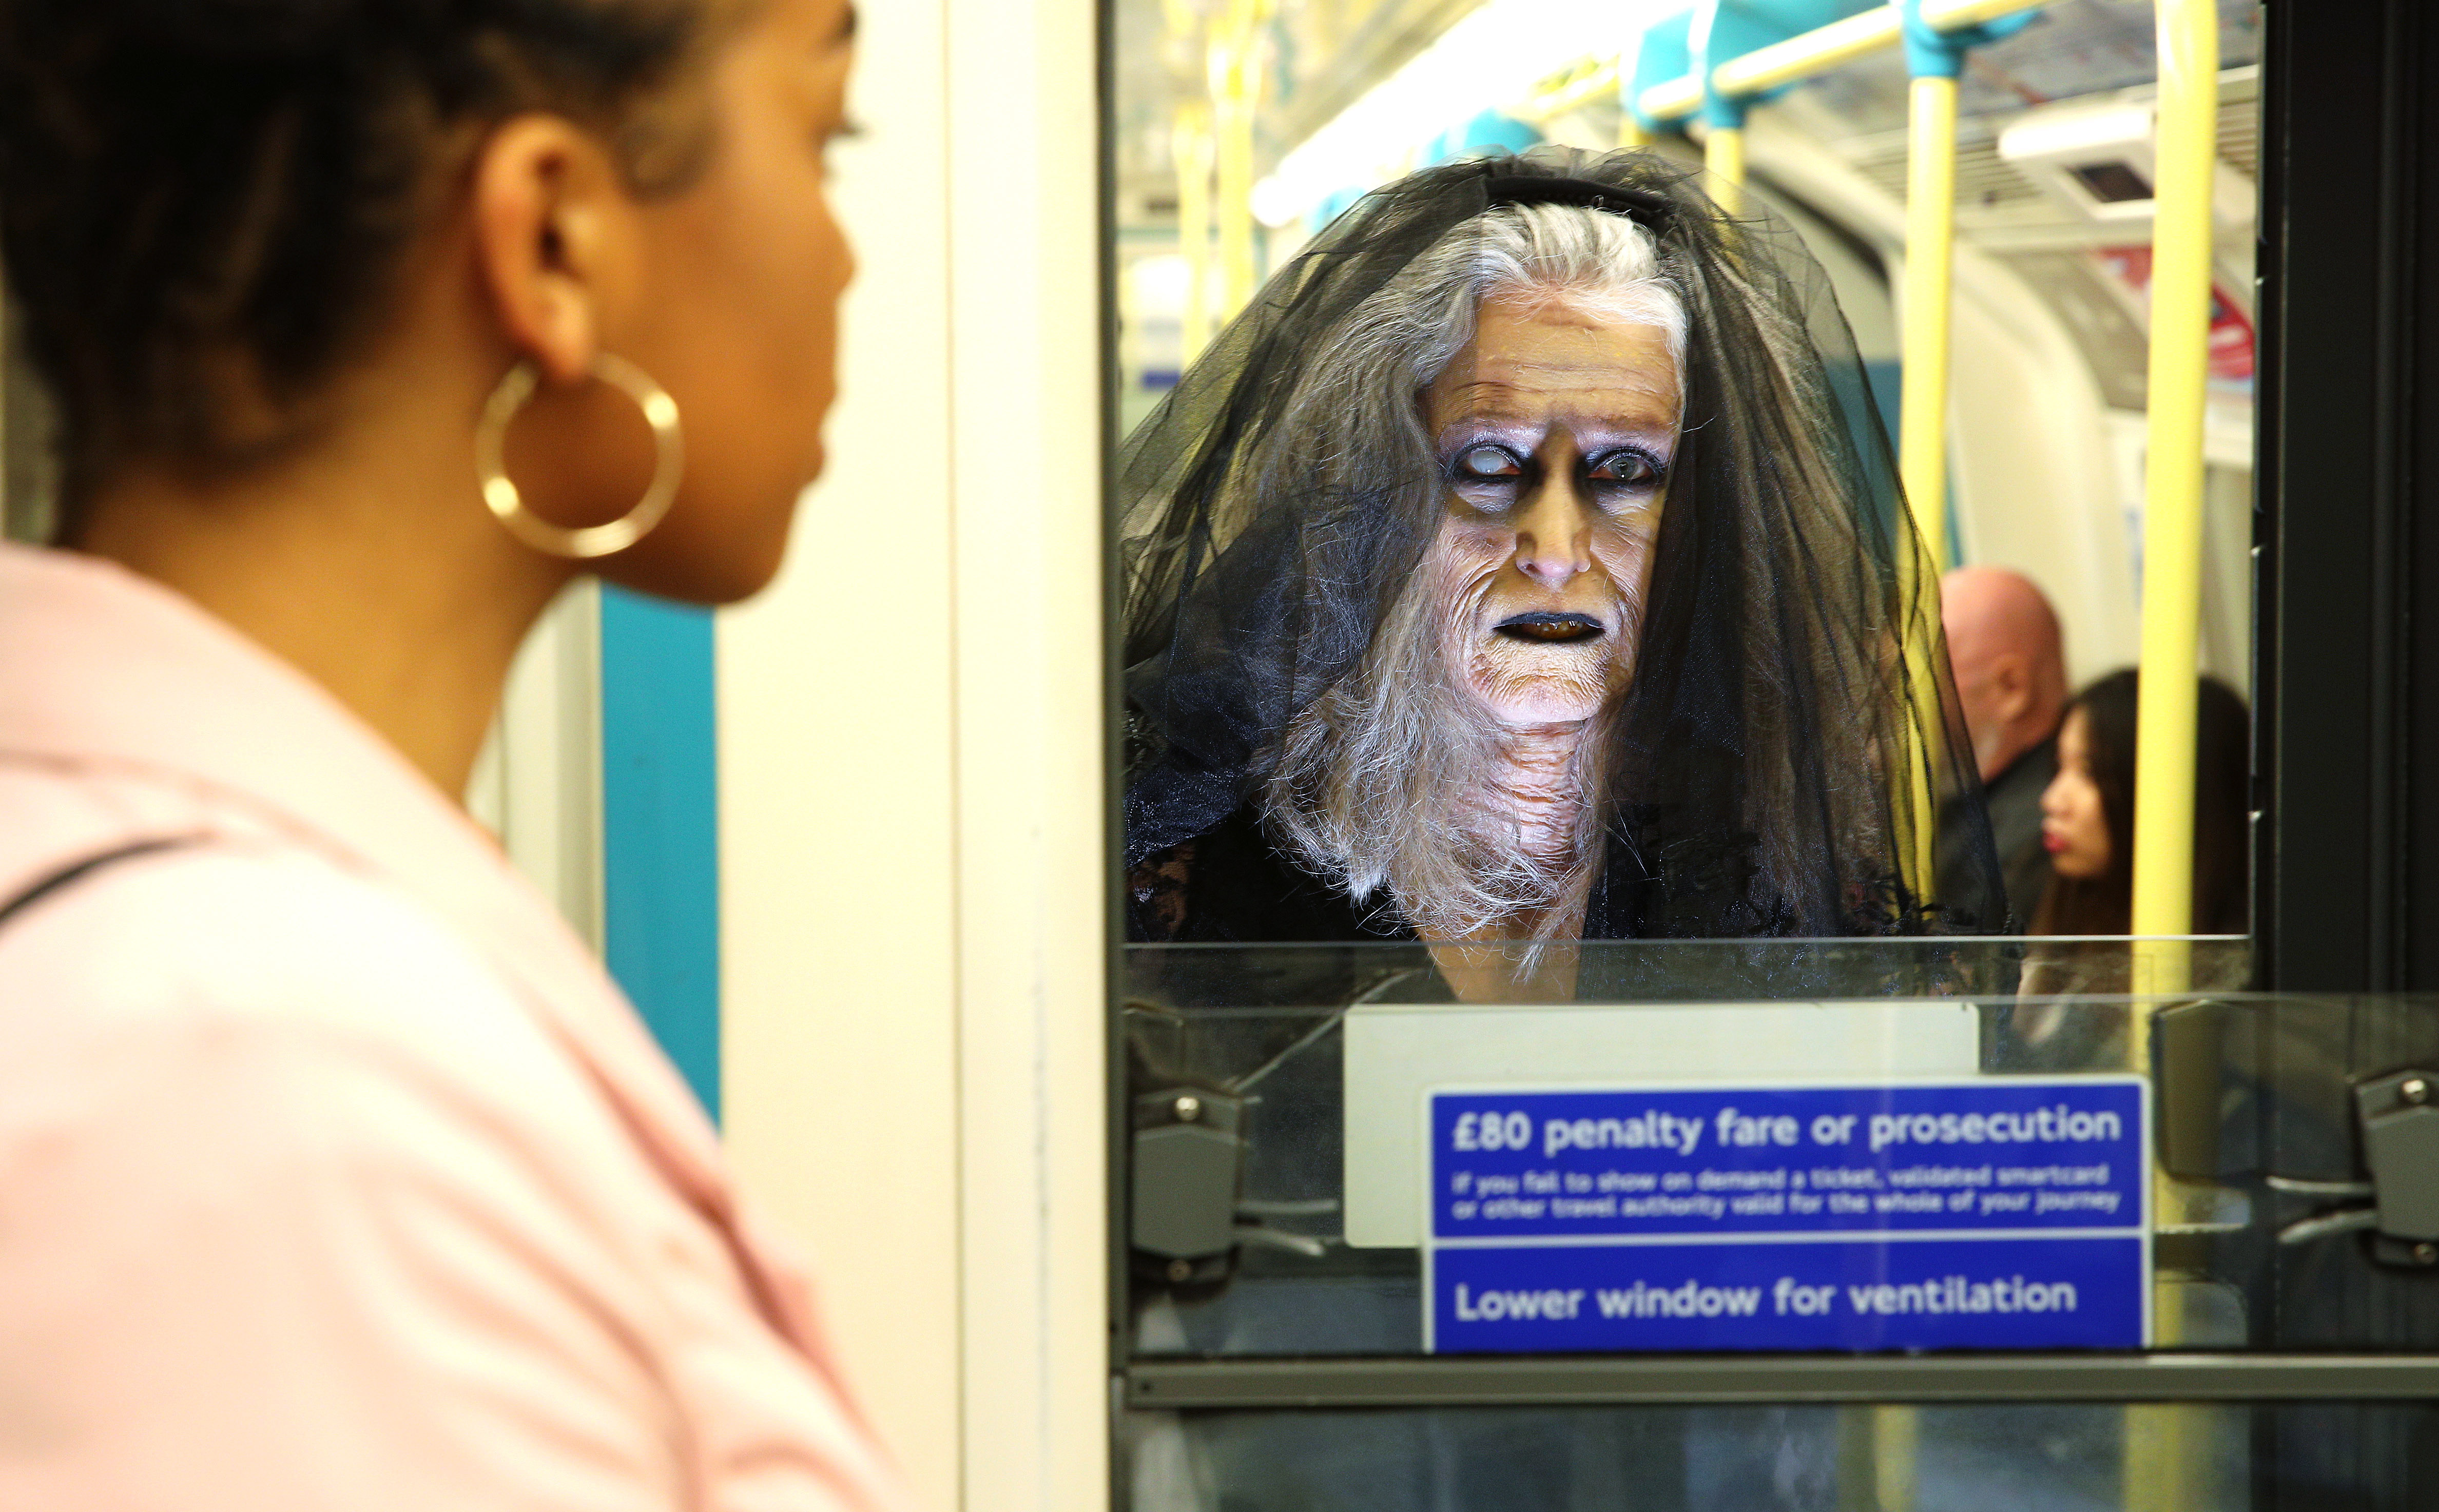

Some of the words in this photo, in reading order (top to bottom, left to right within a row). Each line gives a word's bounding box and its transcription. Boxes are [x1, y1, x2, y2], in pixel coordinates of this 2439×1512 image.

[1453, 1110, 1532, 1152] £80
[1543, 1110, 1705, 1157] penalty
[1715, 1107, 1799, 1147] fare
[1811, 1114, 1857, 1146] or
[1868, 1103, 2121, 1153] prosecution
[1476, 1175, 1520, 1198] you
[1522, 1170, 1560, 1194] fail
[1564, 1172, 1594, 1193] to
[1596, 1170, 1658, 1193] show
[1660, 1172, 1694, 1192] on
[1695, 1168, 1788, 1191] demand
[1789, 1171, 1806, 1189] a
[1887, 1164, 1993, 1188] validated
[1996, 1162, 2111, 1187] smartcard
[1451, 1200, 1478, 1220] or
[1482, 1197, 1546, 1219] other
[1551, 1195, 1618, 1218] travel
[1621, 1193, 1728, 1219] authority
[1730, 1192, 1786, 1216] valid
[1788, 1191, 1823, 1214] for
[1827, 1191, 1870, 1214] the
[1872, 1190, 1944, 1214] whole
[1947, 1188, 1976, 1212] of
[1979, 1192, 2031, 1216] your
[2035, 1191, 2122, 1215] journey
[1455, 1284, 1584, 1322] Lower
[1596, 1281, 1762, 1318] window
[1773, 1276, 1836, 1316] for
[1848, 1276, 2077, 1315] ventilation
